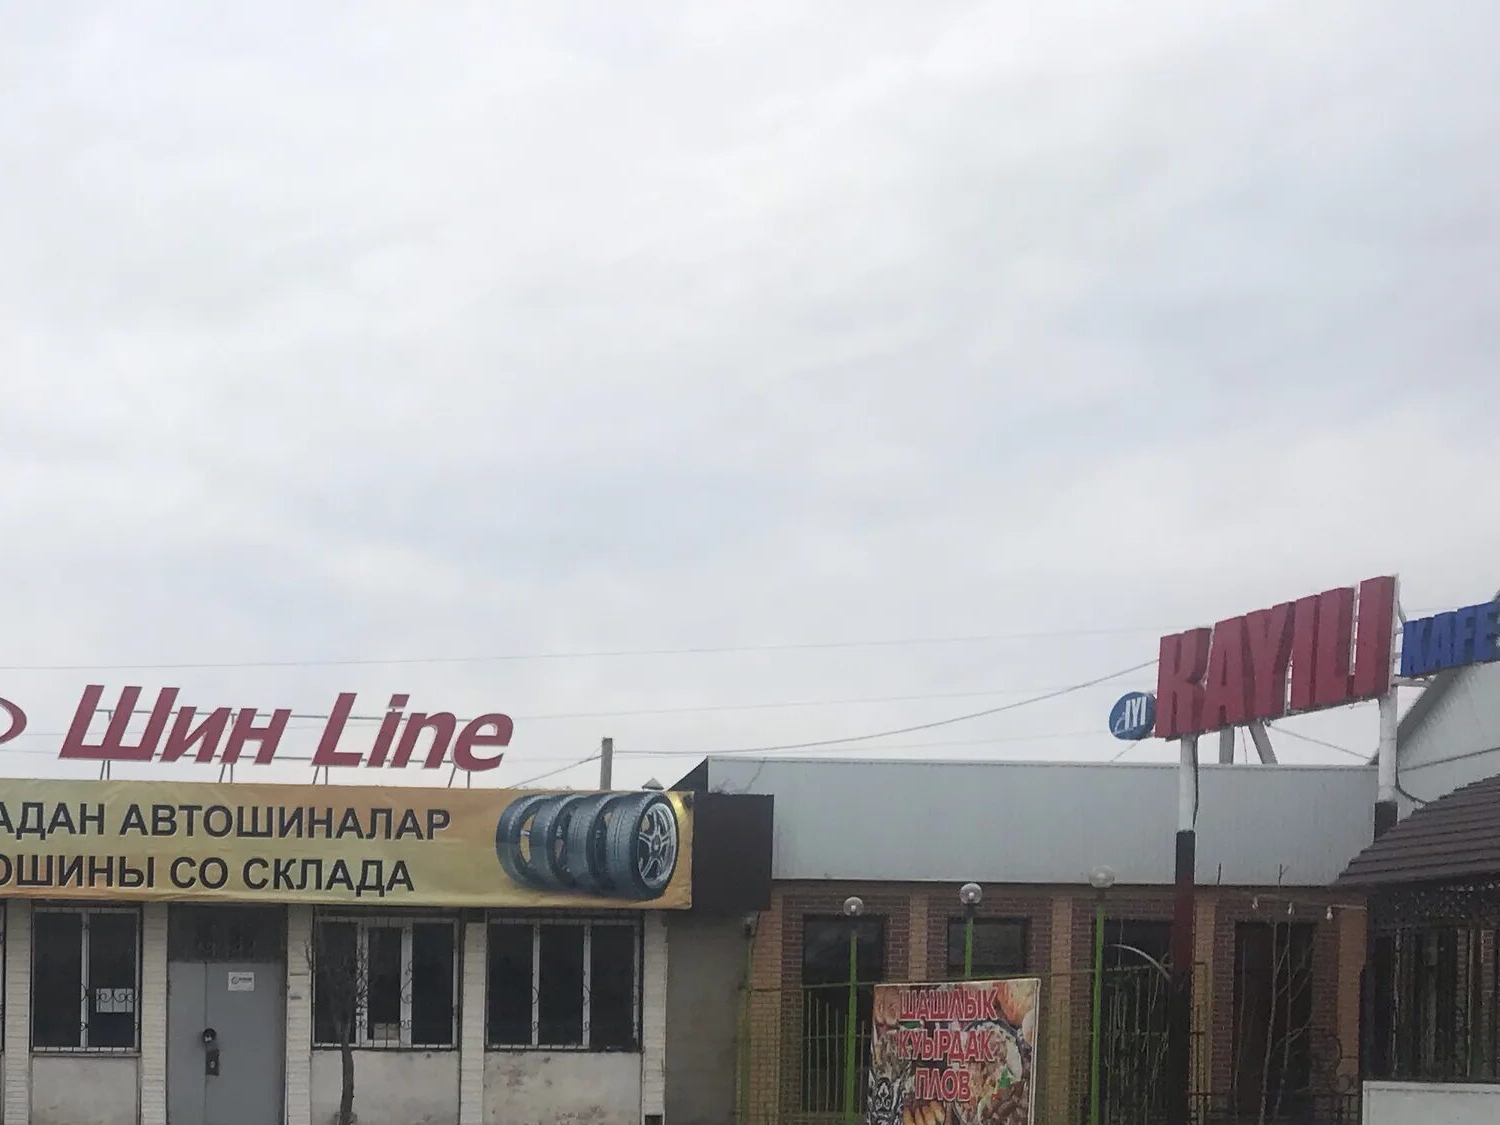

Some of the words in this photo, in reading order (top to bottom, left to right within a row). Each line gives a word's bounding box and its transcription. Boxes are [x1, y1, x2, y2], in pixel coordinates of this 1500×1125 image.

[1401, 600, 1500, 678] KAFE
[57, 684, 293, 765] Шин
[310, 692, 514, 772] Line
[119, 803, 451, 840] АВТОШИНАЛАР
[169, 856, 228, 889] СО
[242, 857, 415, 898] СКЛАДА
[899, 987, 999, 1021] ШАШЛЫК
[898, 1029, 995, 1066] КУЫРДАК
[915, 1067, 972, 1101] ПЛОВ
